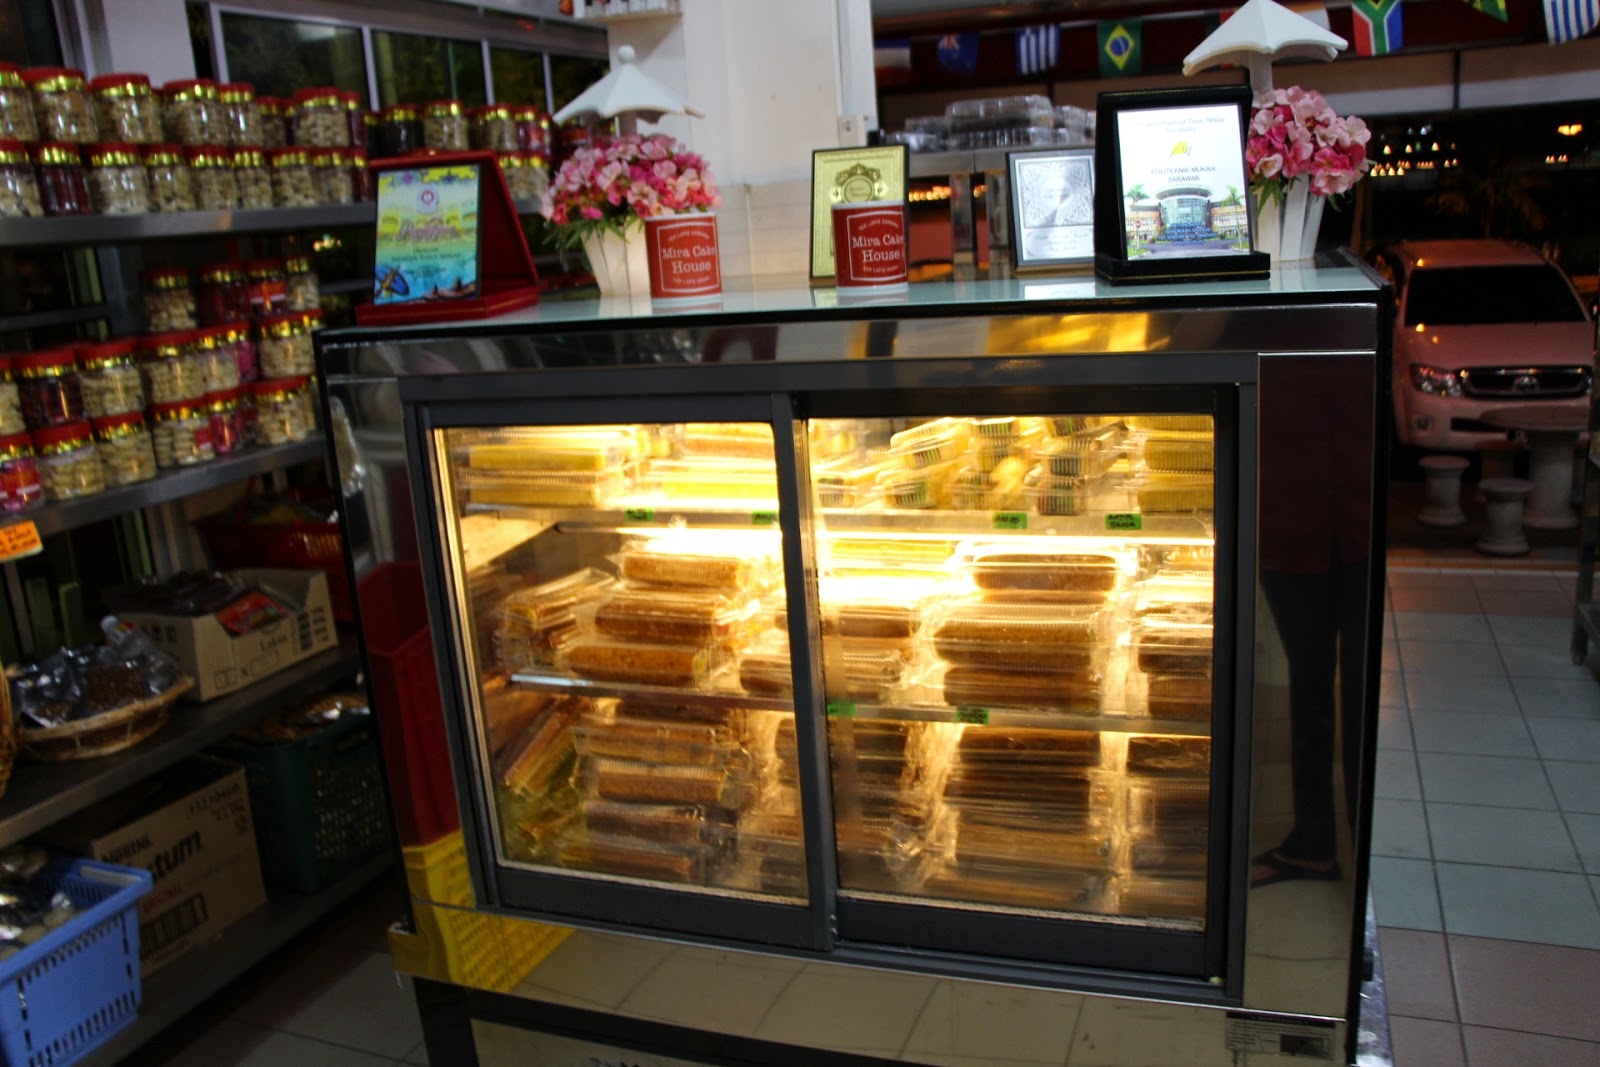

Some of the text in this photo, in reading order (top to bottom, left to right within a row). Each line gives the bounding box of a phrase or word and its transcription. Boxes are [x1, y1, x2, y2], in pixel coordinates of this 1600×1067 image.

[1151, 165, 1216, 175] POLITEKNIK MUKAH
[1168, 175, 1201, 183] SARAWAK
[852, 234, 904, 248] Mira Cake
[662, 244, 716, 259] Mira Cake
[862, 249, 900, 263] House
[671, 260, 711, 274] House
